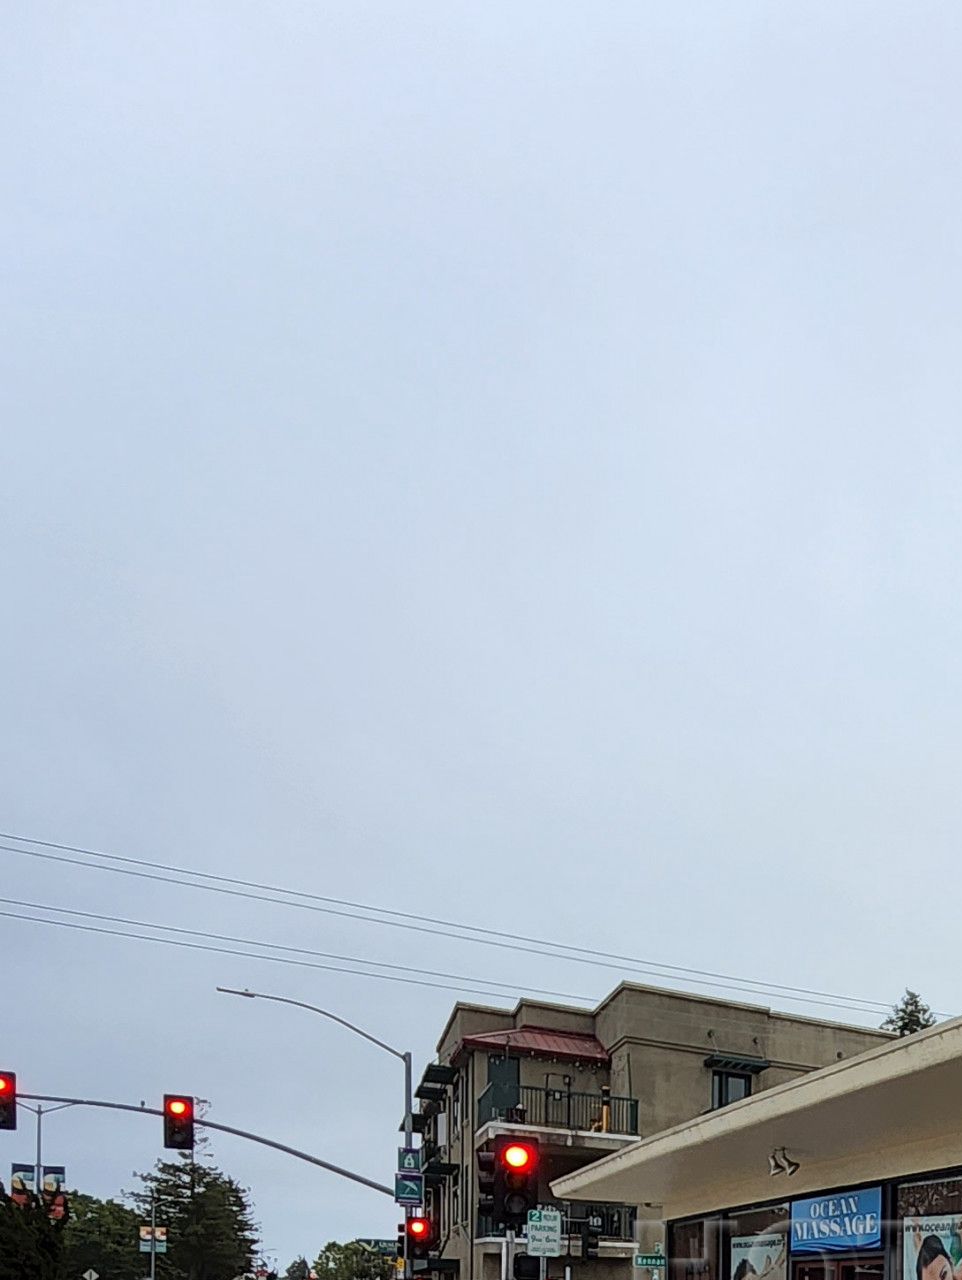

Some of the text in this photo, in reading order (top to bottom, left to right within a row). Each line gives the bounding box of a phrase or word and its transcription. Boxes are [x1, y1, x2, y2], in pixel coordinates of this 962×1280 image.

[531, 1211, 541, 1221] 2
[810, 1196, 859, 1218] OCEAN
[795, 1212, 878, 1240] MASSAGE
